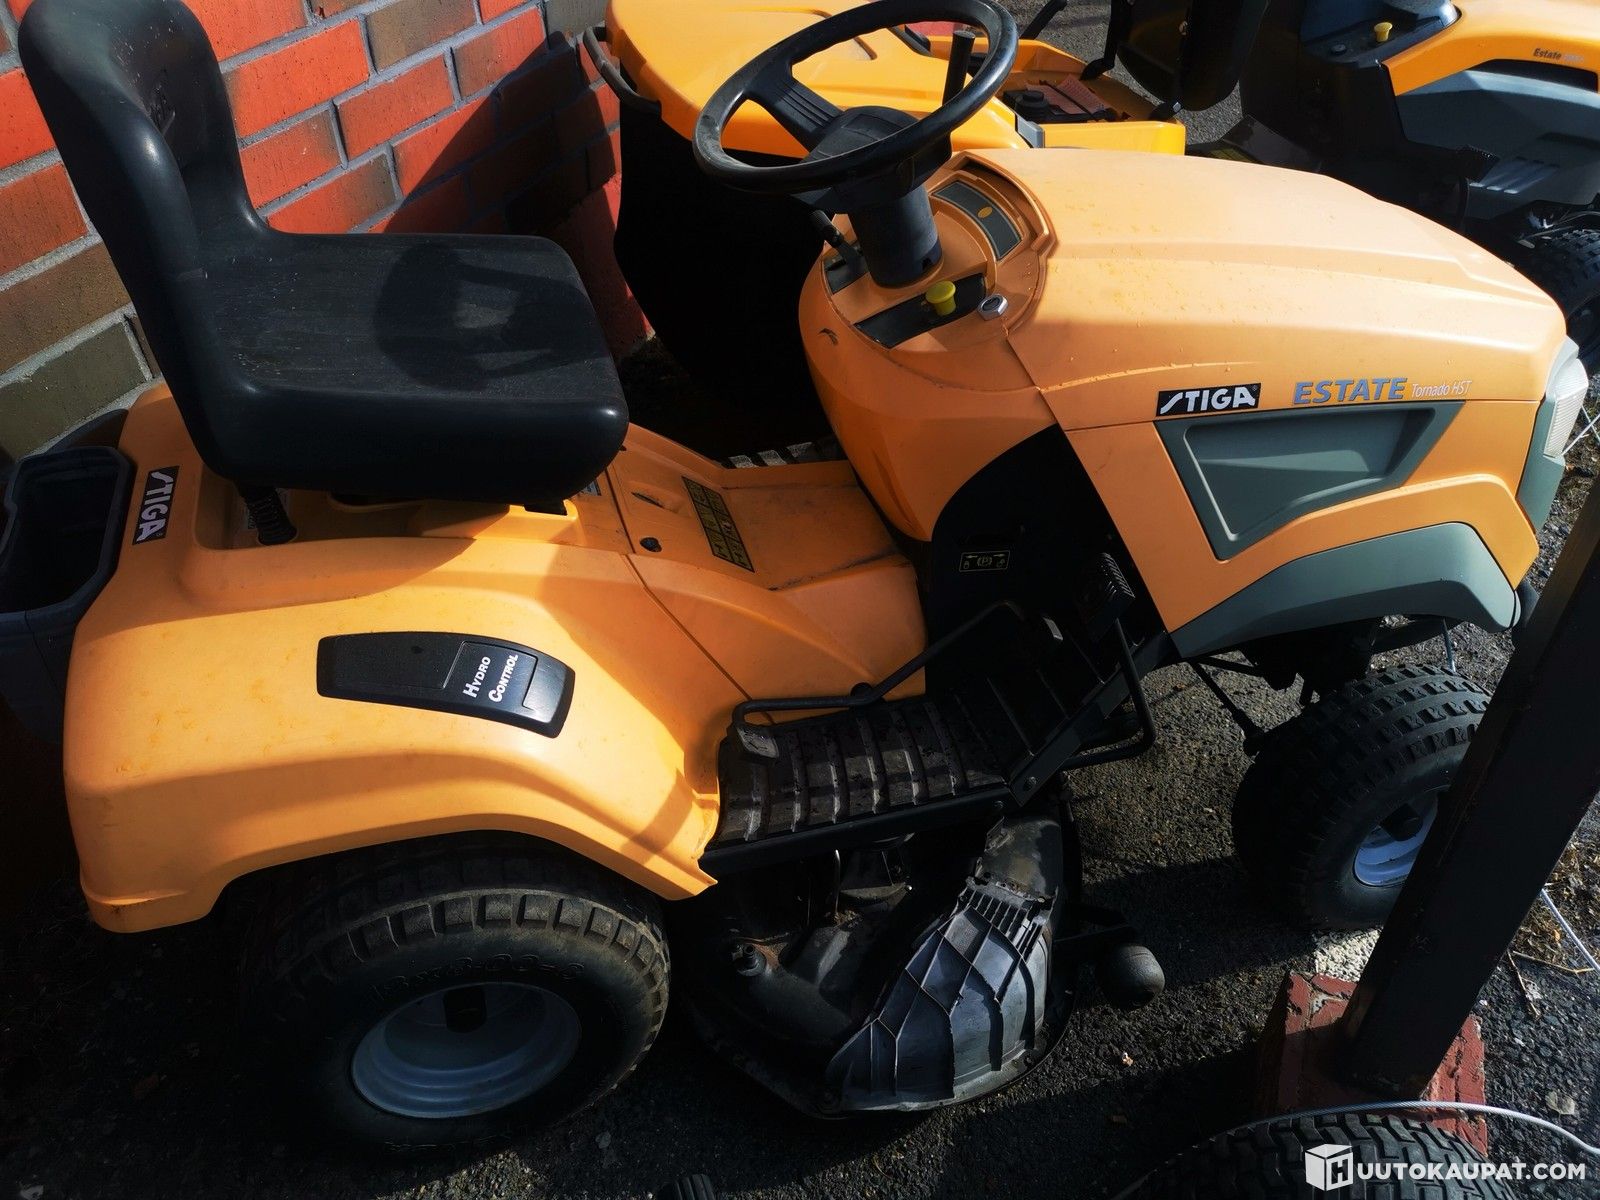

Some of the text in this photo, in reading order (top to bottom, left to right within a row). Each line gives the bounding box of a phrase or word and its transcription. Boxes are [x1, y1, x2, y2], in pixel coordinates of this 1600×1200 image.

[1159, 386, 1256, 415] STIGA
[1293, 377, 1473, 405] ESTATE Tornado HST
[136, 471, 174, 542] STIGA
